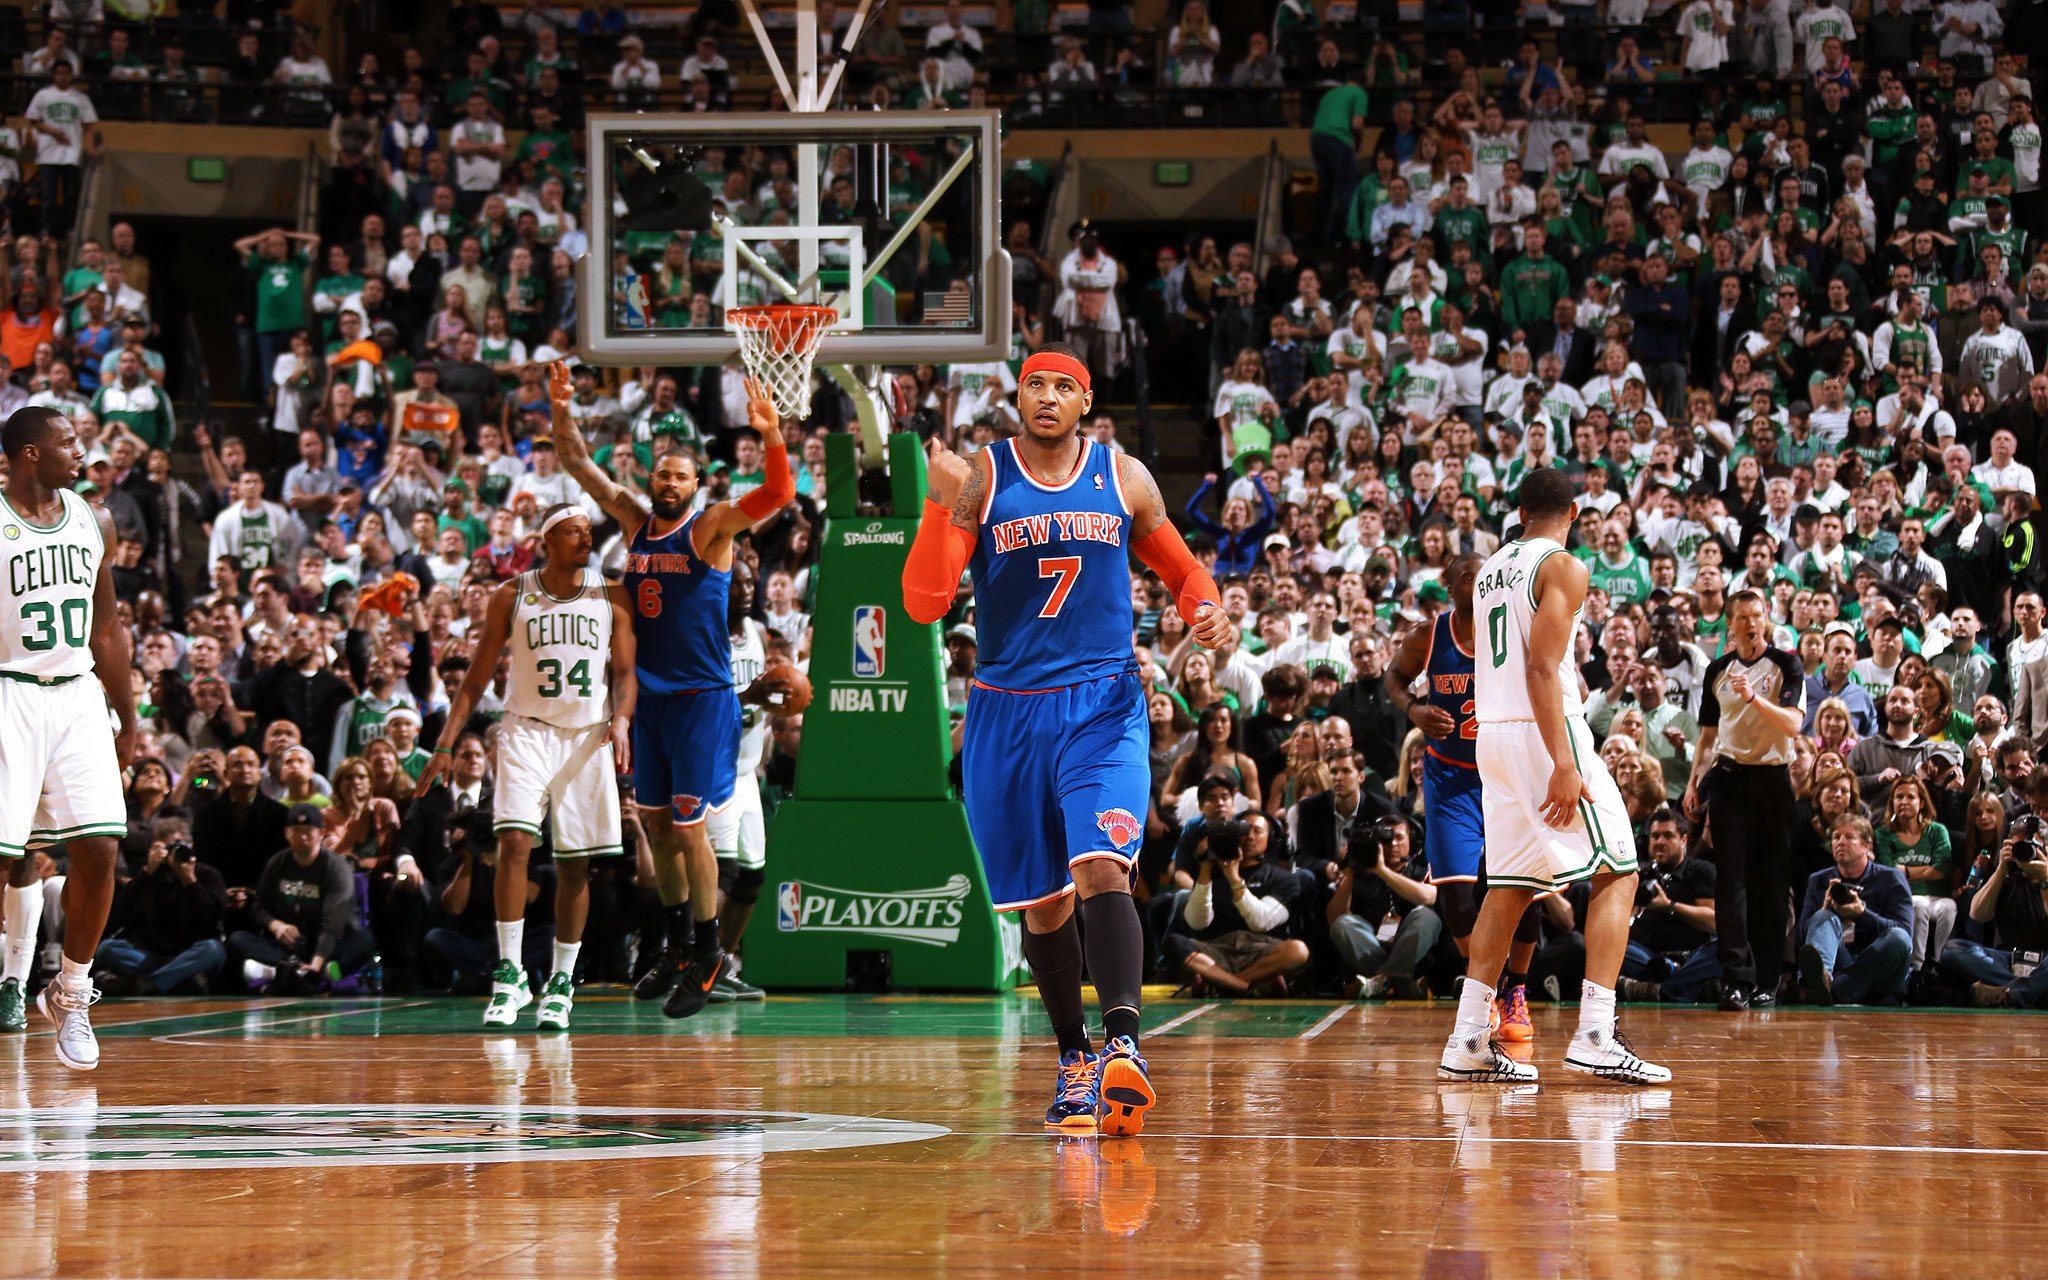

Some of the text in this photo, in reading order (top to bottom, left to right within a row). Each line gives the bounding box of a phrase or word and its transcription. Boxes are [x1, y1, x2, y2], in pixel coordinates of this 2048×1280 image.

[1982, 364, 1995, 382] 5
[844, 531, 905, 546] SPALDING
[992, 511, 1122, 554] NEW YORK
[10, 544, 92, 597] CELTICS
[241, 546, 268, 569] 34
[626, 553, 691, 574] EW YORK
[638, 579, 662, 618] 6
[1038, 555, 1082, 618] 7
[20, 598, 88, 652] 30
[527, 613, 599, 650] CELTICS
[537, 658, 592, 698] 34
[857, 662, 875, 673] NBA
[1432, 673, 1469, 694] NEW
[830, 688, 908, 712] NBA TV
[801, 896, 964, 927] PLAYOFFS
